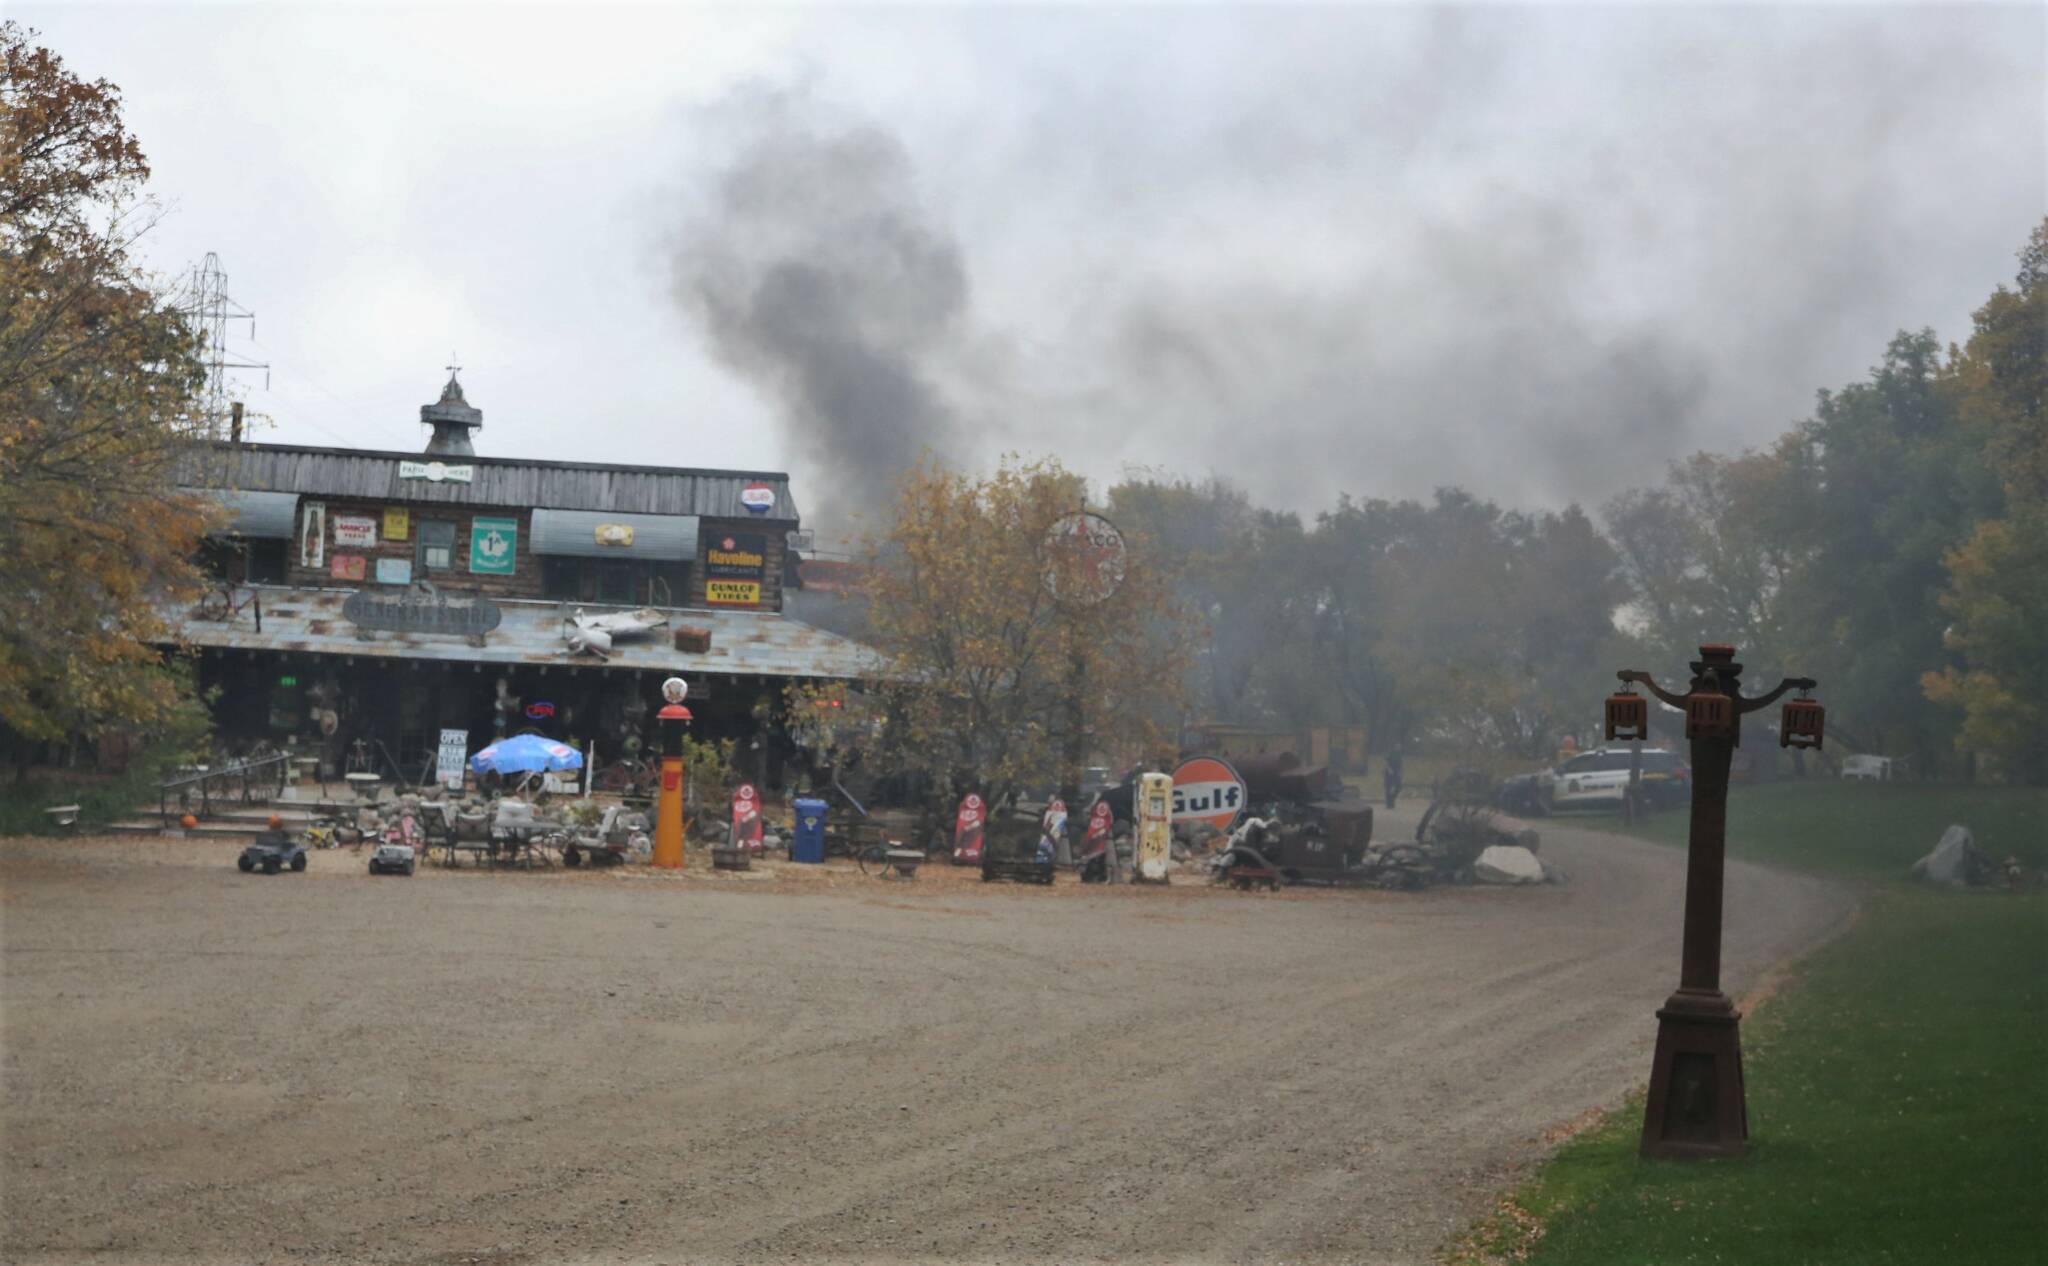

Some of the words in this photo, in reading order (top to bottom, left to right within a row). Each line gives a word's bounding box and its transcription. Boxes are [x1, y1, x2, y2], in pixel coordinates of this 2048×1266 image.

[708, 549, 762, 567] Havoline
[711, 583, 755, 593] DUNLOP
[716, 592, 751, 600] TIRES
[441, 732, 467, 745] OPEN
[1172, 786, 1239, 813] Gulf
